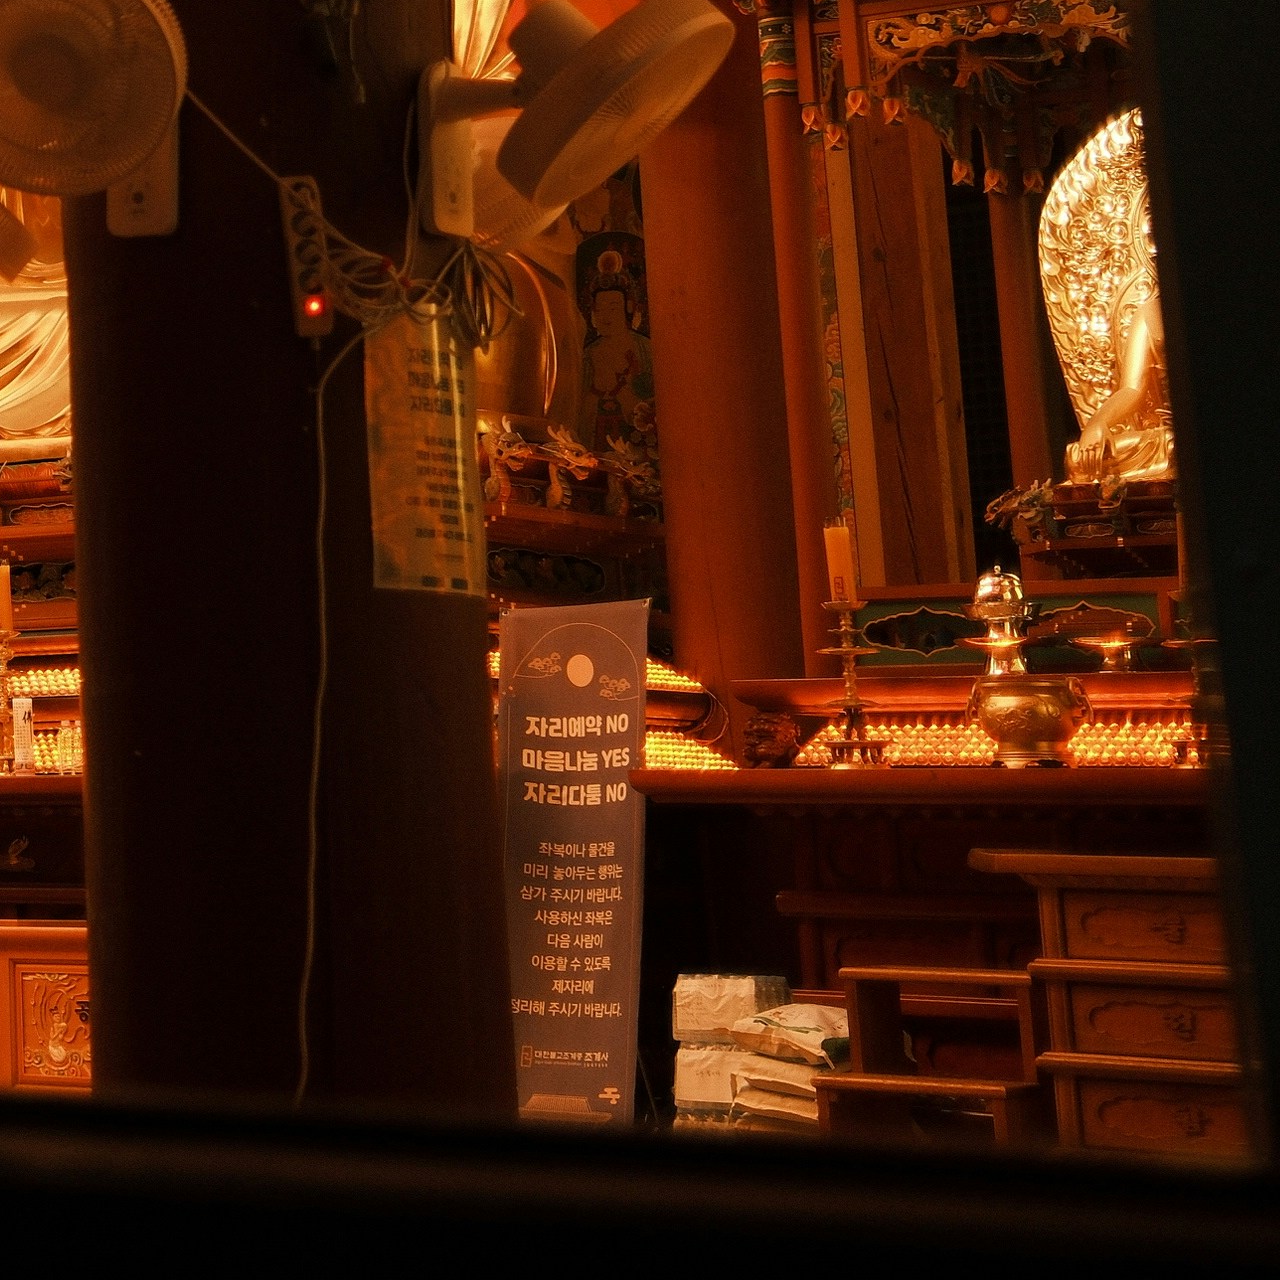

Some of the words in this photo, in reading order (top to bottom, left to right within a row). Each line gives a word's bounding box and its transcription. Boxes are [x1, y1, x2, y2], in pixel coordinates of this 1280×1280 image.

[526, 715, 603, 738] 자리예약
[606, 713, 629, 734] NO
[522, 748, 599, 772] 마음나눔
[601, 747, 630, 768] YES
[524, 782, 602, 806] 자리다툼
[606, 782, 627, 802] NO
[539, 842, 585, 858] 좌복이나
[588, 841, 615, 857] 물건을
[523, 863, 548, 879] 미리
[553, 865, 596, 880] 놓아두는
[598, 863, 624, 879] 행위는
[520, 885, 547, 901] 삼가
[550, 888, 584, 903] 주시기
[586, 886, 623, 902] 바랍니다.
[534, 910, 582, 925] 사용하신
[584, 910, 613, 925] 좌복은
[547, 933, 571, 949] 다음
[573, 933, 603, 949] 사람이
[531, 955, 568, 971] 이용할
[570, 958, 581, 972] 수
[584, 956, 611, 972] 있도록
[551, 979, 594, 995] 제자리에
[548, 1002, 581, 1017] 주시기
[584, 1002, 622, 1018] 바랍니다.
